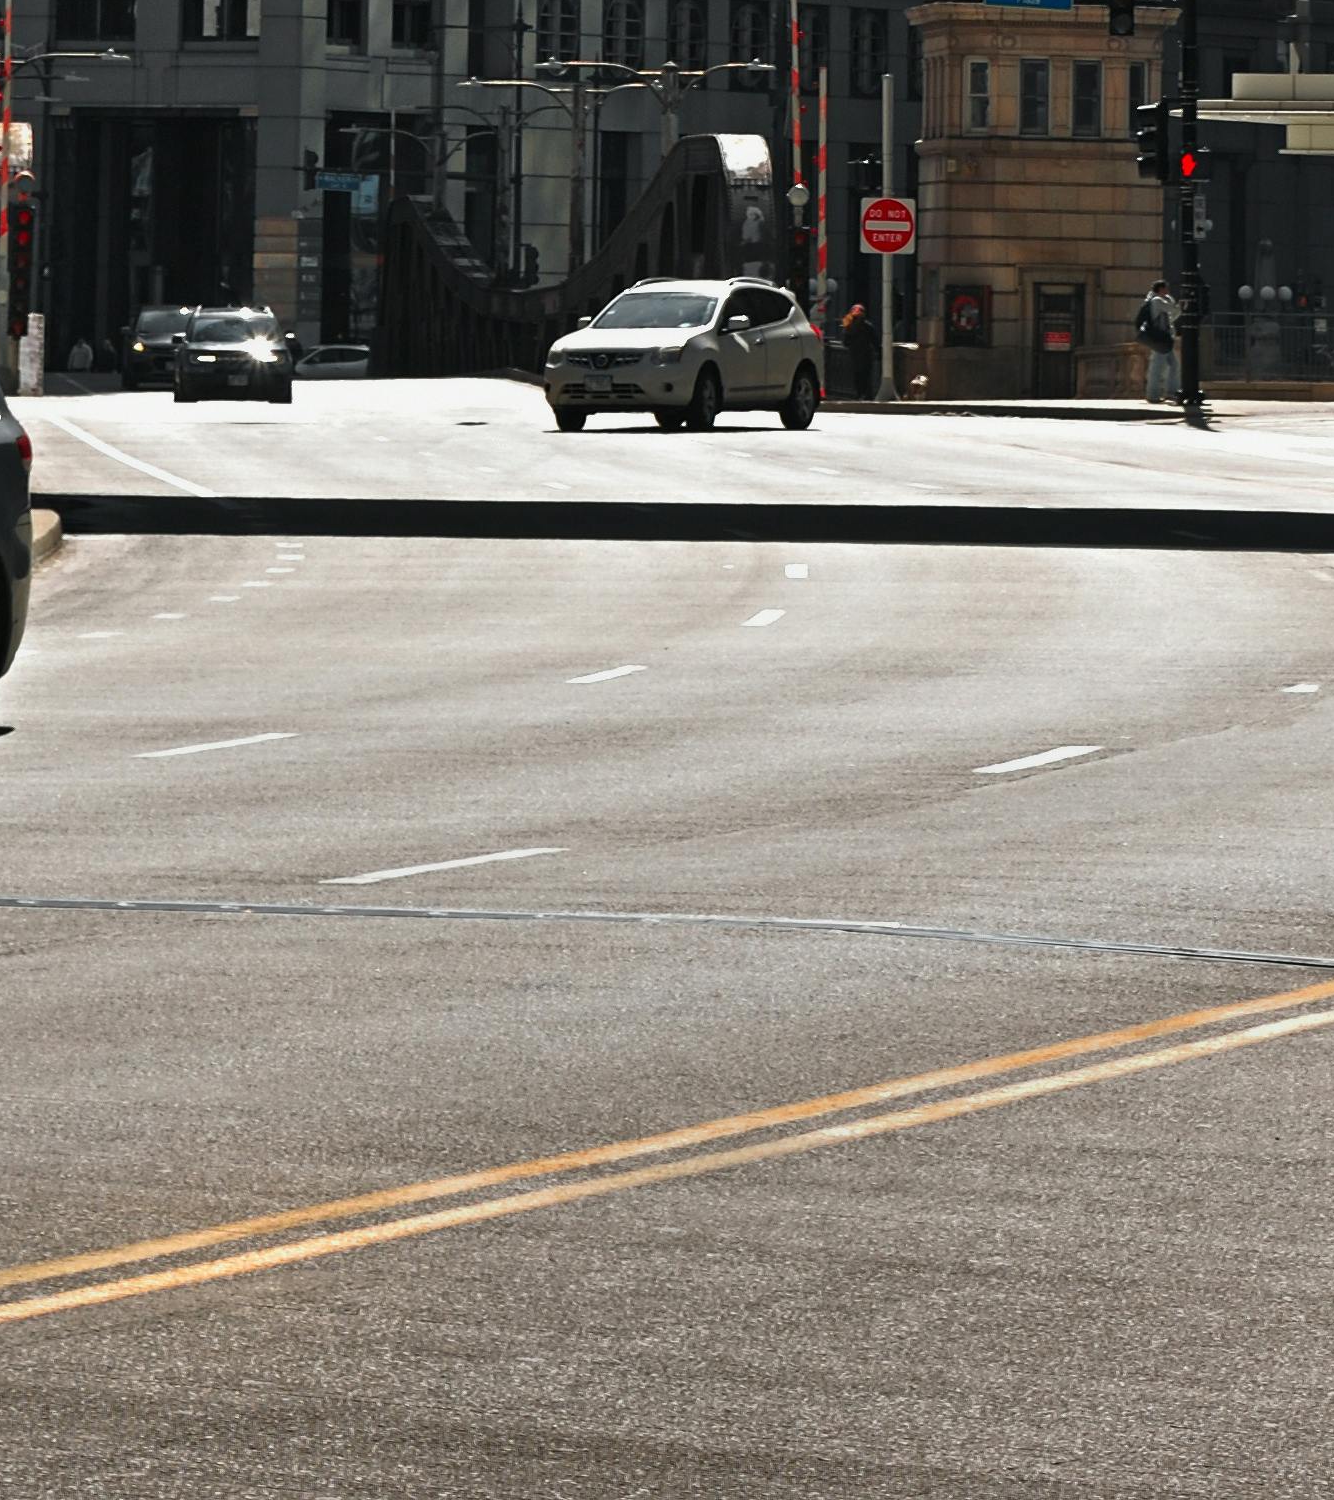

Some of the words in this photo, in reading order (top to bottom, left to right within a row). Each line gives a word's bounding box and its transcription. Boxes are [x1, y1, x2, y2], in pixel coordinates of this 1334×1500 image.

[869, 209, 882, 218] DO
[887, 210, 906, 219] NOT
[872, 233, 903, 242] ENTER
